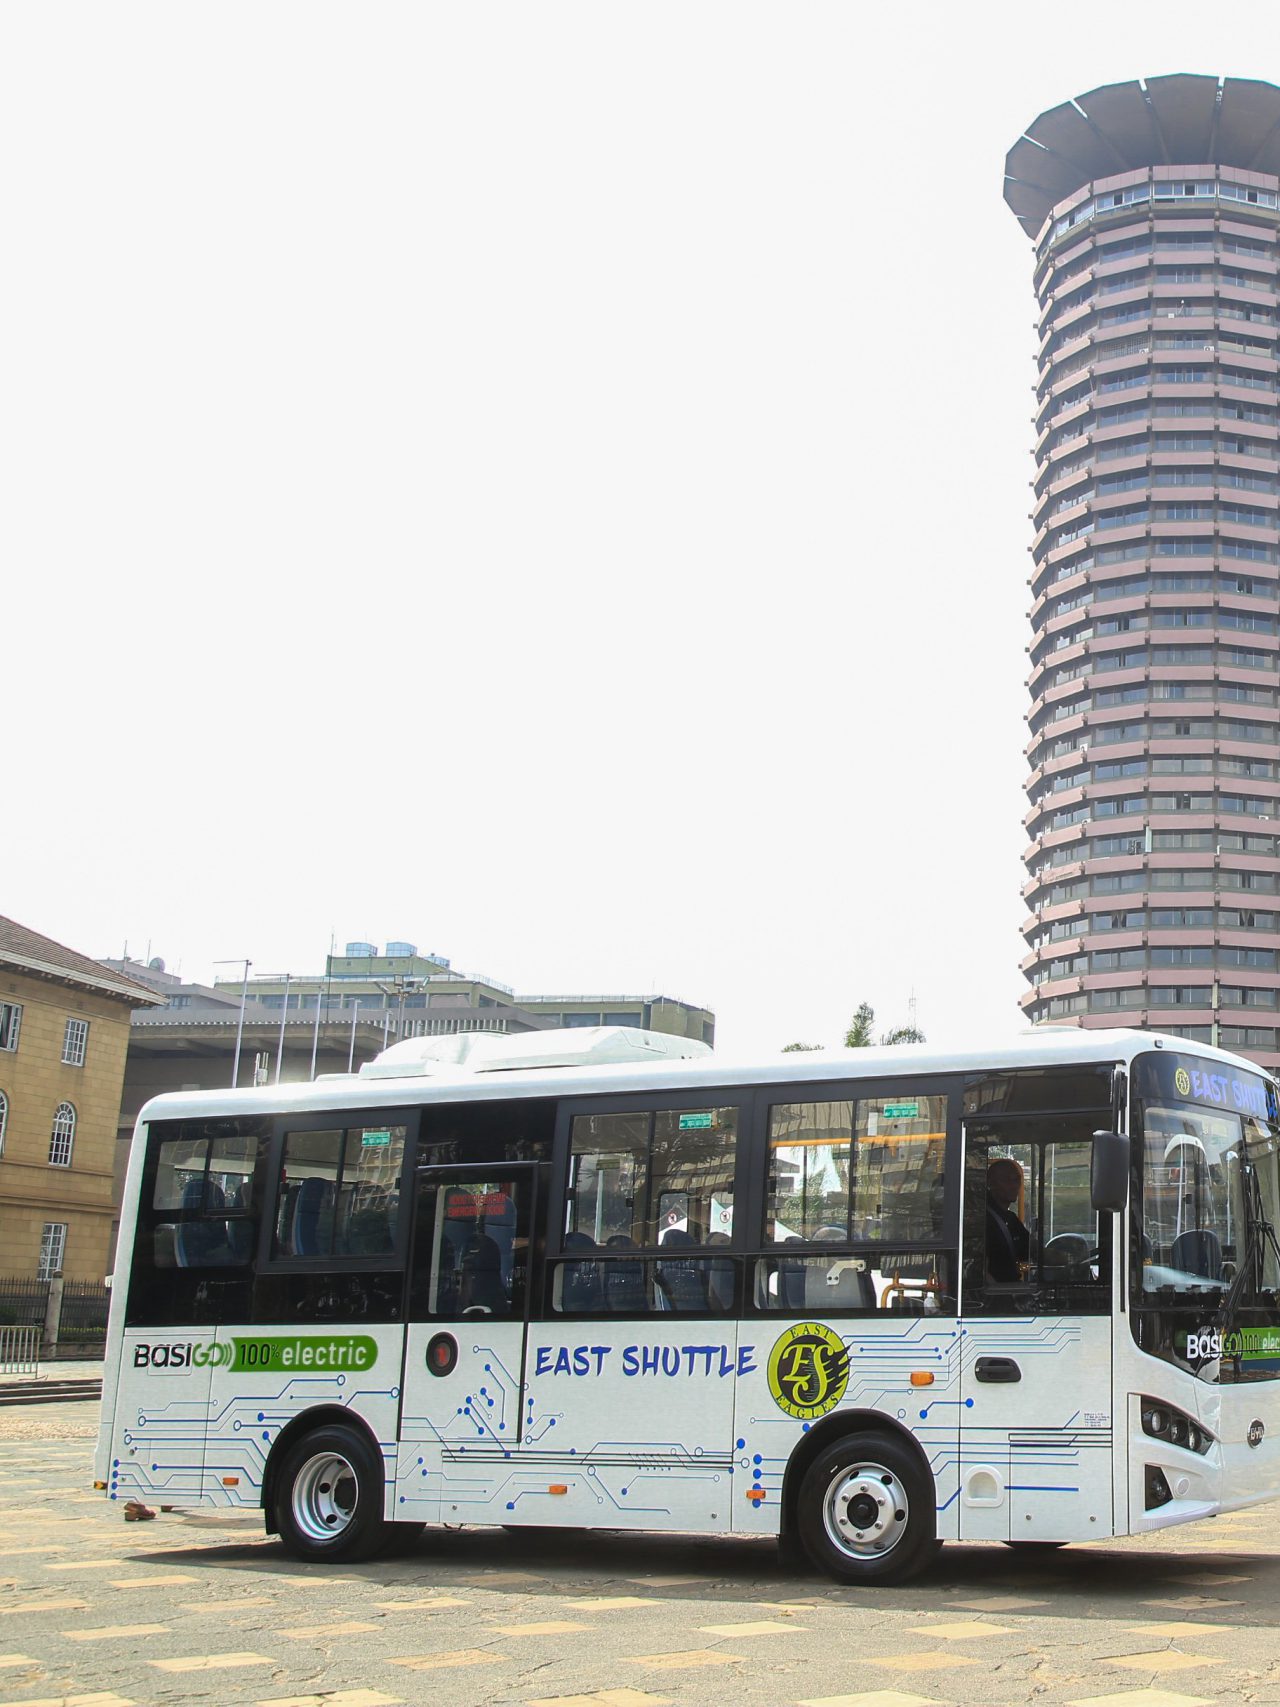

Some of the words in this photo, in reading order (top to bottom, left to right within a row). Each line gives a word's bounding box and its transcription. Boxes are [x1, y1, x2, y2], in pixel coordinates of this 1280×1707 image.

[1190, 1070, 1228, 1104] EAST
[790, 1324, 833, 1340] EAST
[281, 1340, 368, 1366] electric
[535, 1345, 612, 1377] EAST
[622, 1345, 759, 1378] SHUTTLE
[776, 1394, 838, 1419] EAGLES
